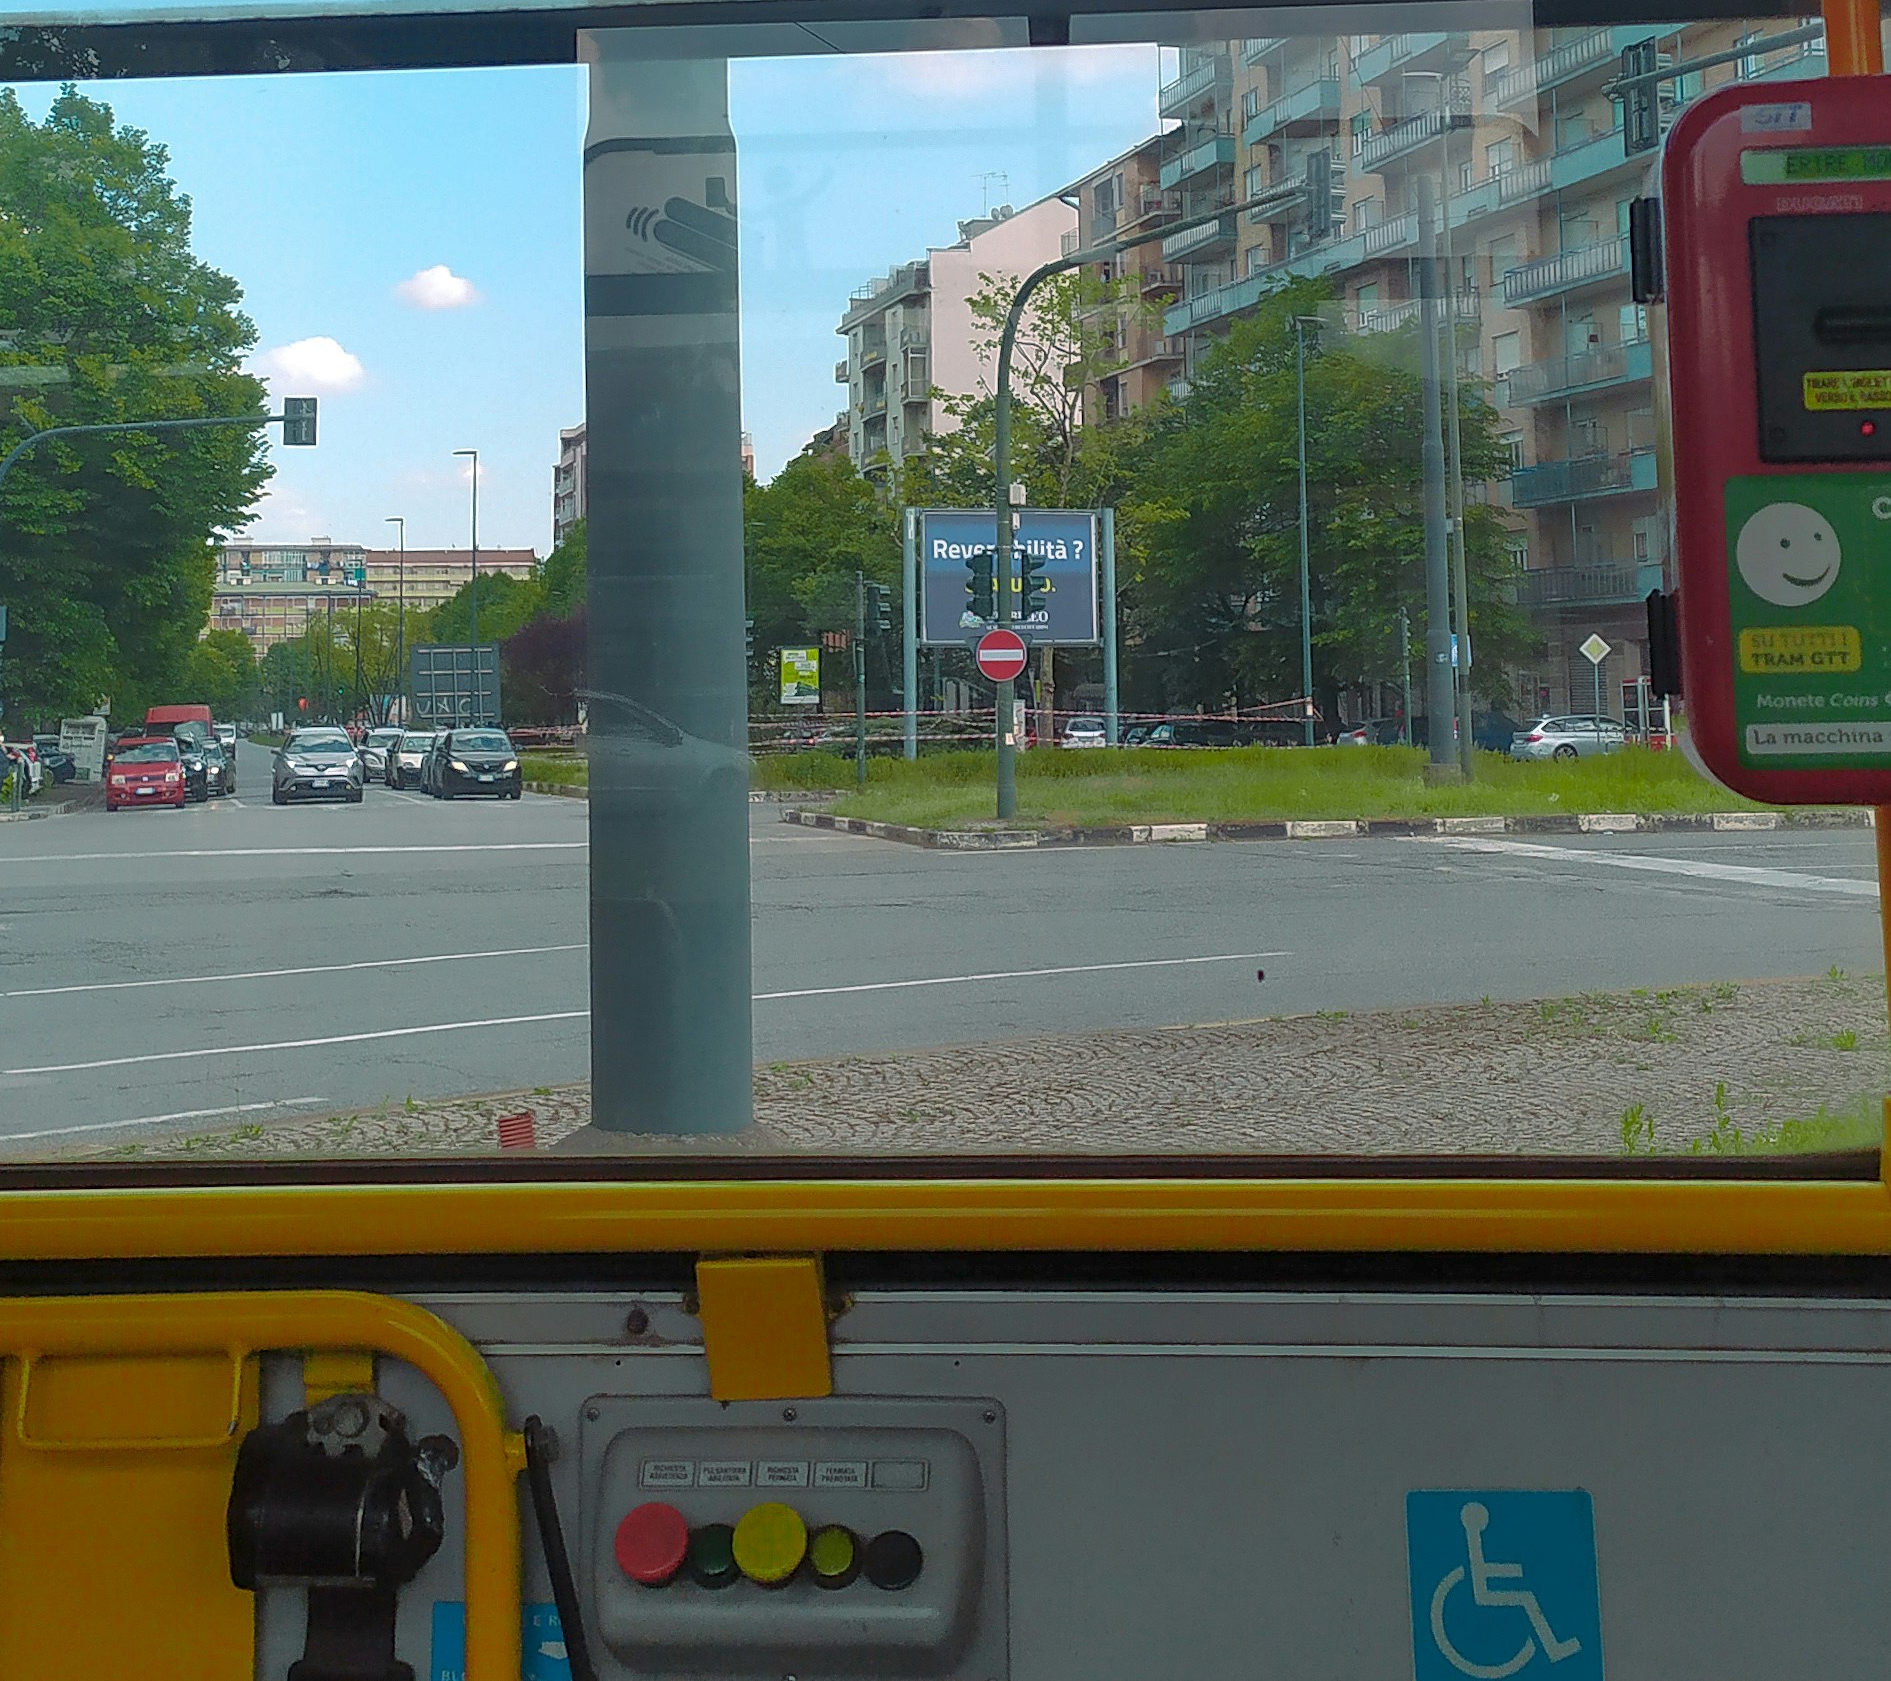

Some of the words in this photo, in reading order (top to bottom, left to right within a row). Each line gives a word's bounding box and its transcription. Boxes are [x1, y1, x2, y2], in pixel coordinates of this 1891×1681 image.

[933, 538, 1069, 560] Reverbilità
[1751, 652, 1805, 666] TRAM
[1811, 651, 1851, 665] GTT
[1757, 694, 1826, 708] Monete
[1829, 692, 1879, 708] Coins
[1753, 728, 1777, 745] La
[1782, 727, 1884, 744] macchina
